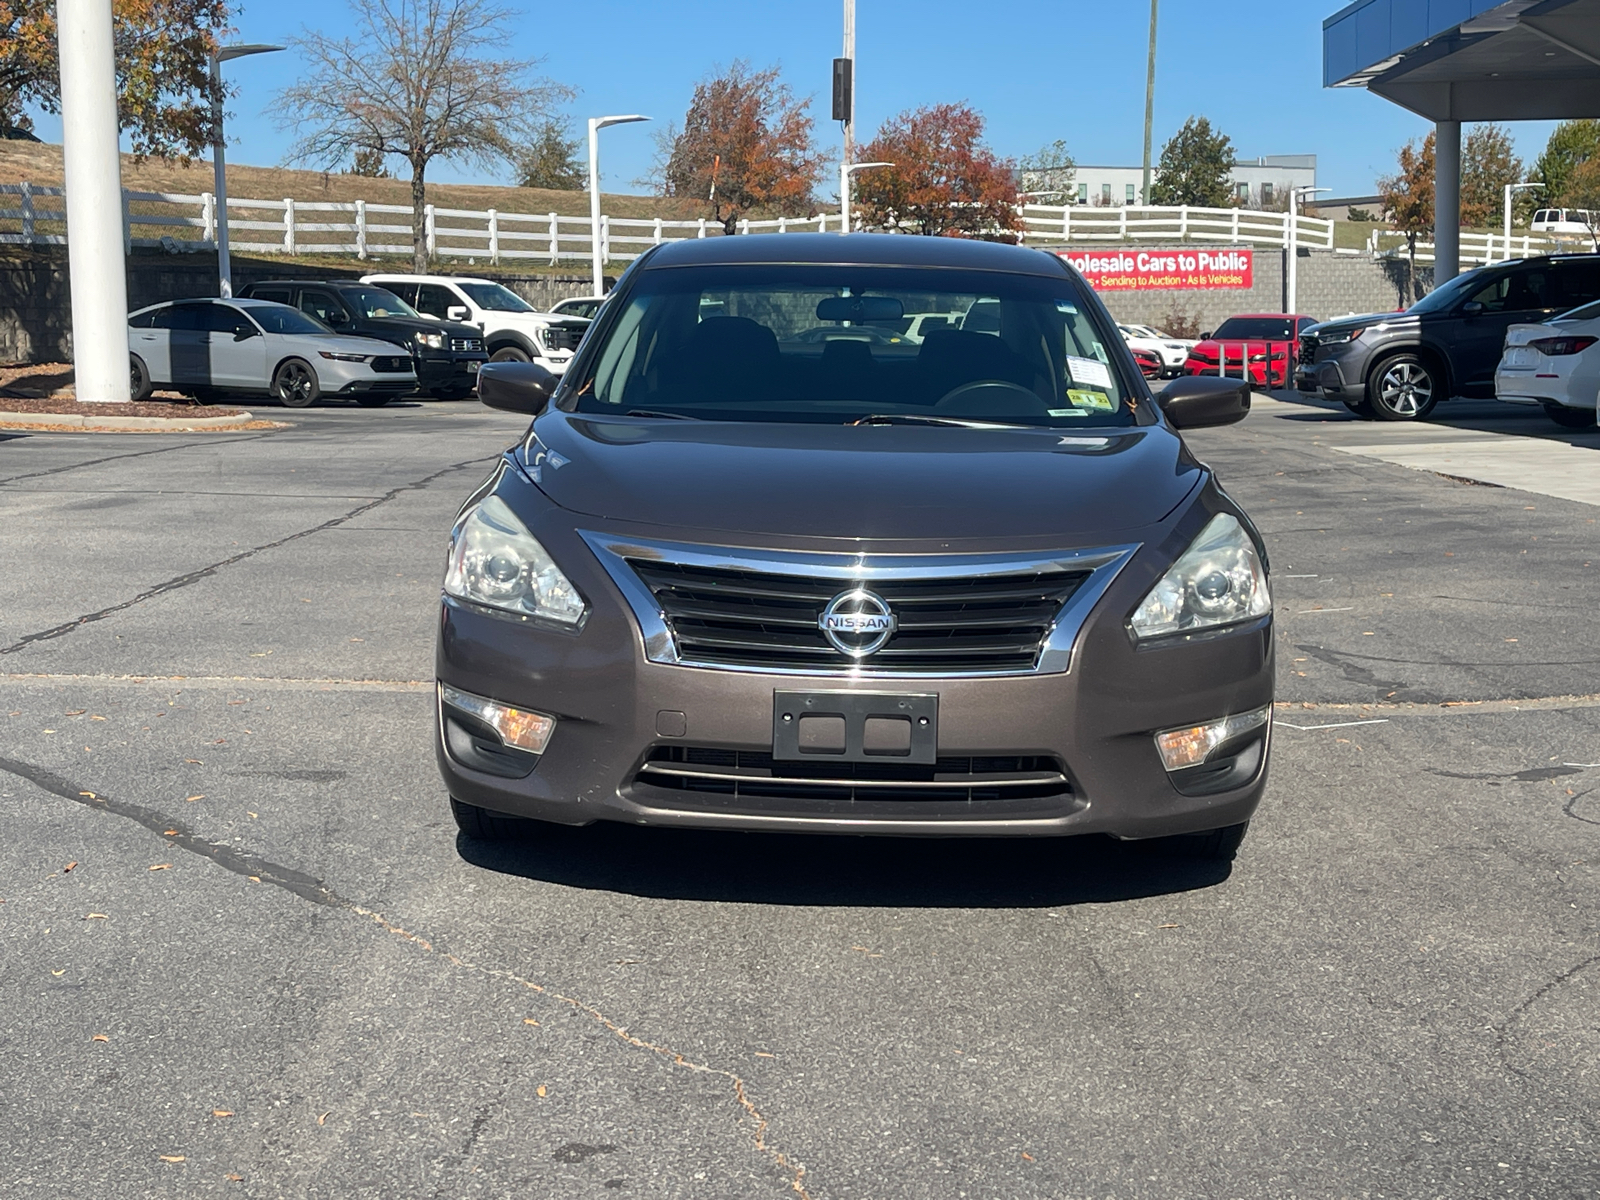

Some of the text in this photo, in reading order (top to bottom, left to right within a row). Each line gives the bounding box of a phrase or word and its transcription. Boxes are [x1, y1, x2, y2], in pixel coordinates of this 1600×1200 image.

[1060, 252, 1248, 273] olesale Cars to Public
[1101, 275, 1137, 288] Sending
[1138, 276, 1147, 286] to
[1148, 275, 1181, 286] Auction
[1187, 274, 1199, 285] As
[1207, 274, 1243, 285] Vehicles
[826, 617, 889, 628] NISSAN
